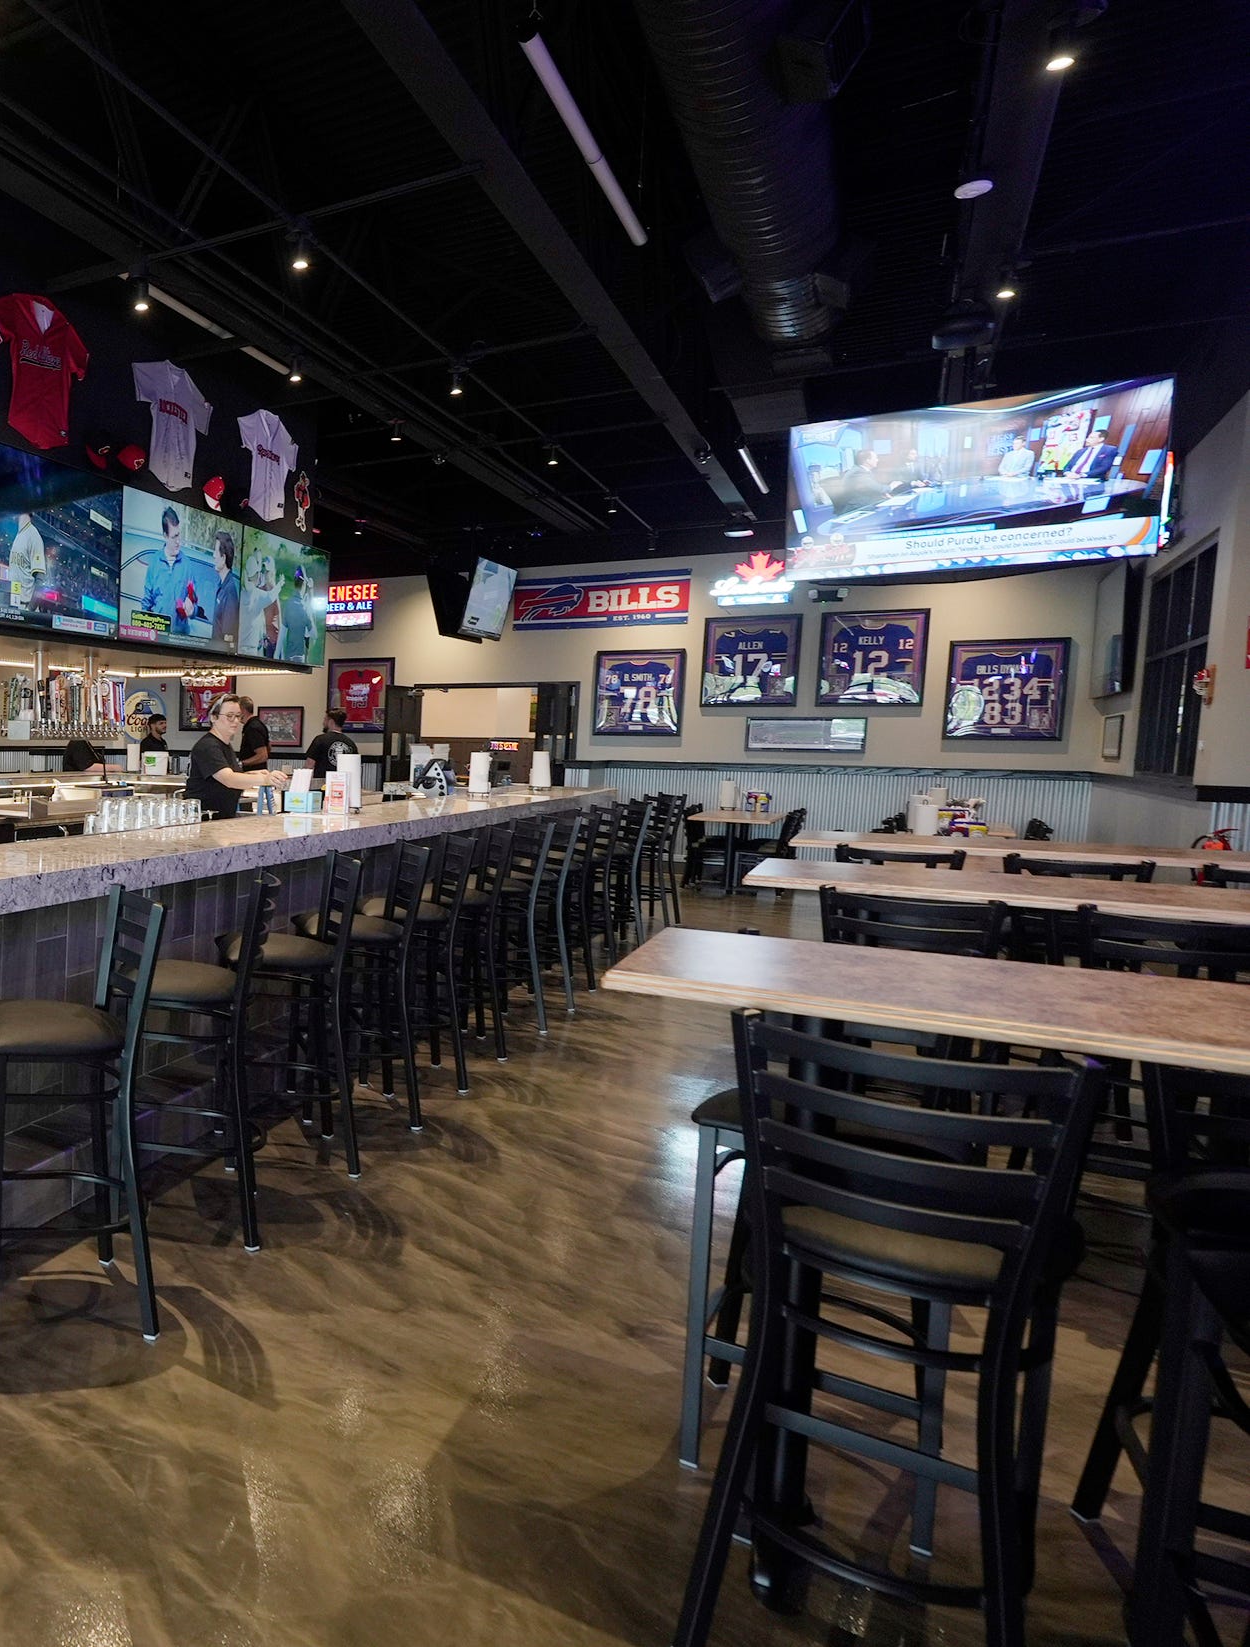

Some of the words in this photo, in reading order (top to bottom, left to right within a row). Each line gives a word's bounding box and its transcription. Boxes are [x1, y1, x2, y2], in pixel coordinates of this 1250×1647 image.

[905, 540, 945, 550] Should
[947, 537, 981, 547] Purdy
[984, 534, 998, 543] be
[1000, 527, 1073, 542] concerned?
[328, 583, 380, 602] ENESEE
[588, 585, 680, 613] BILLS
[347, 602, 355, 611] &
[356, 600, 373, 610] ALE
[633, 613, 652, 621] 1960
[737, 641, 764, 650] ALLEN
[858, 635, 885, 646] KELLY
[898, 638, 914, 650] 12
[833, 643, 848, 654] 12
[732, 653, 769, 678] 17
[852, 650, 890, 678] 12
[976, 665, 999, 675] BILLS
[605, 674, 618, 684] 78
[631, 673, 654, 681] SMITH
[619, 686, 657, 714] 78
[983, 702, 1023, 725] 83
[127, 713, 151, 727] Coo
[130, 726, 150, 734] LIGH
